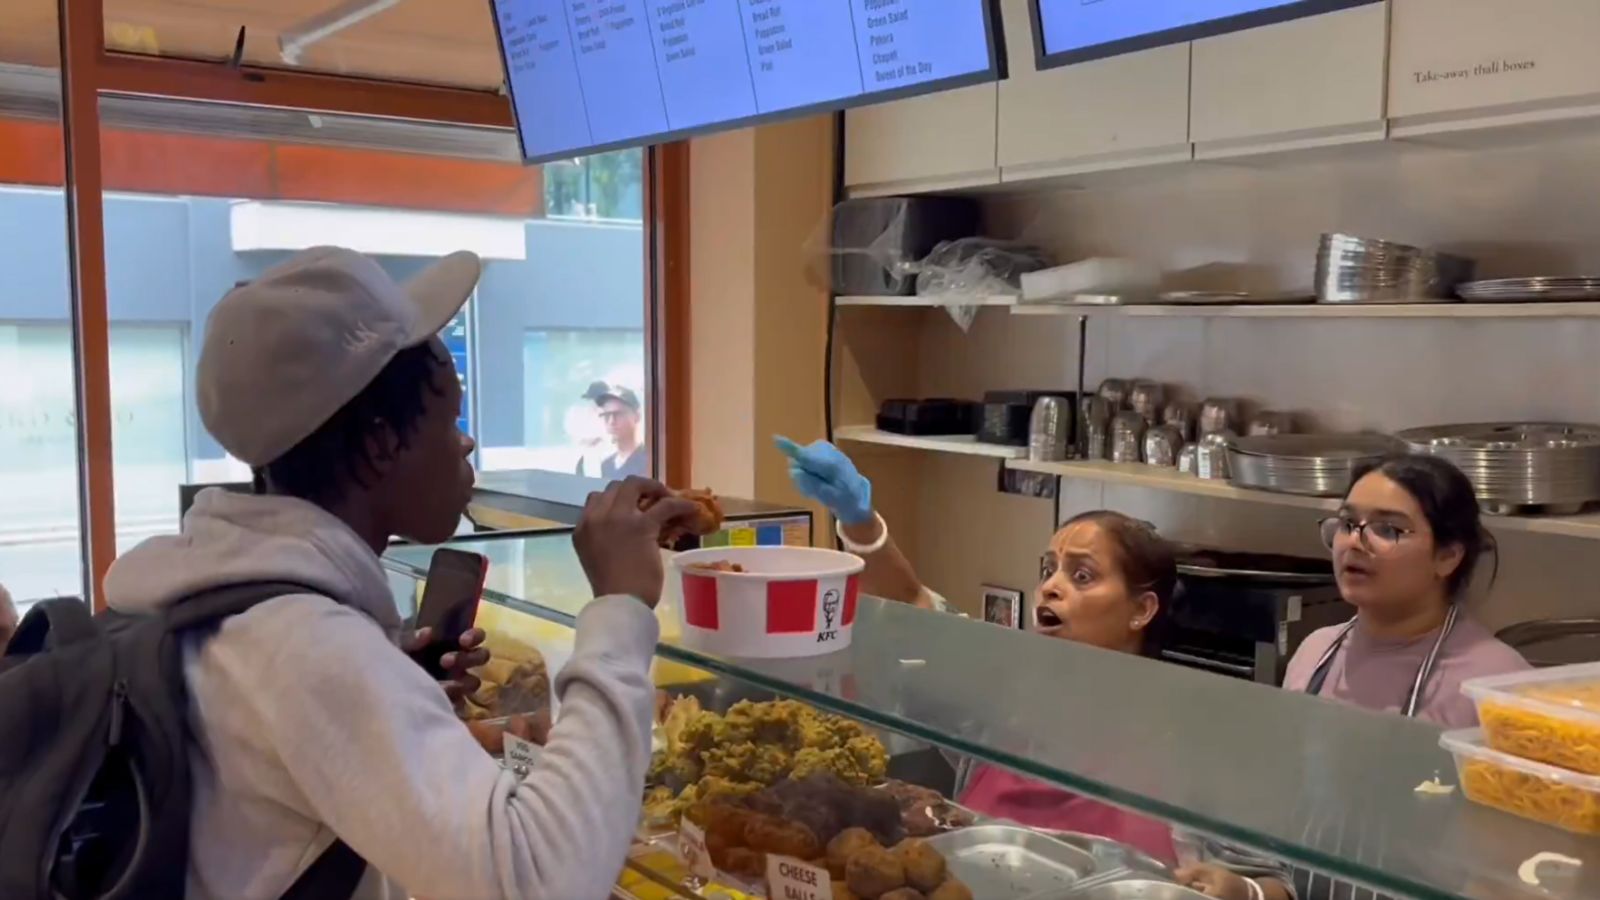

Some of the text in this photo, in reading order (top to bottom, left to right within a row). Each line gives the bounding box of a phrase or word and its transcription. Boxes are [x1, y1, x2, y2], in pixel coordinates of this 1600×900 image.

[867, 9, 908, 28] Green Salad
[875, 62, 932, 82] Sweet of the Day
[1413, 60, 1535, 83] Take-away thali boxes
[816, 630, 838, 643] KFC
[779, 862, 818, 888] CHEESE
